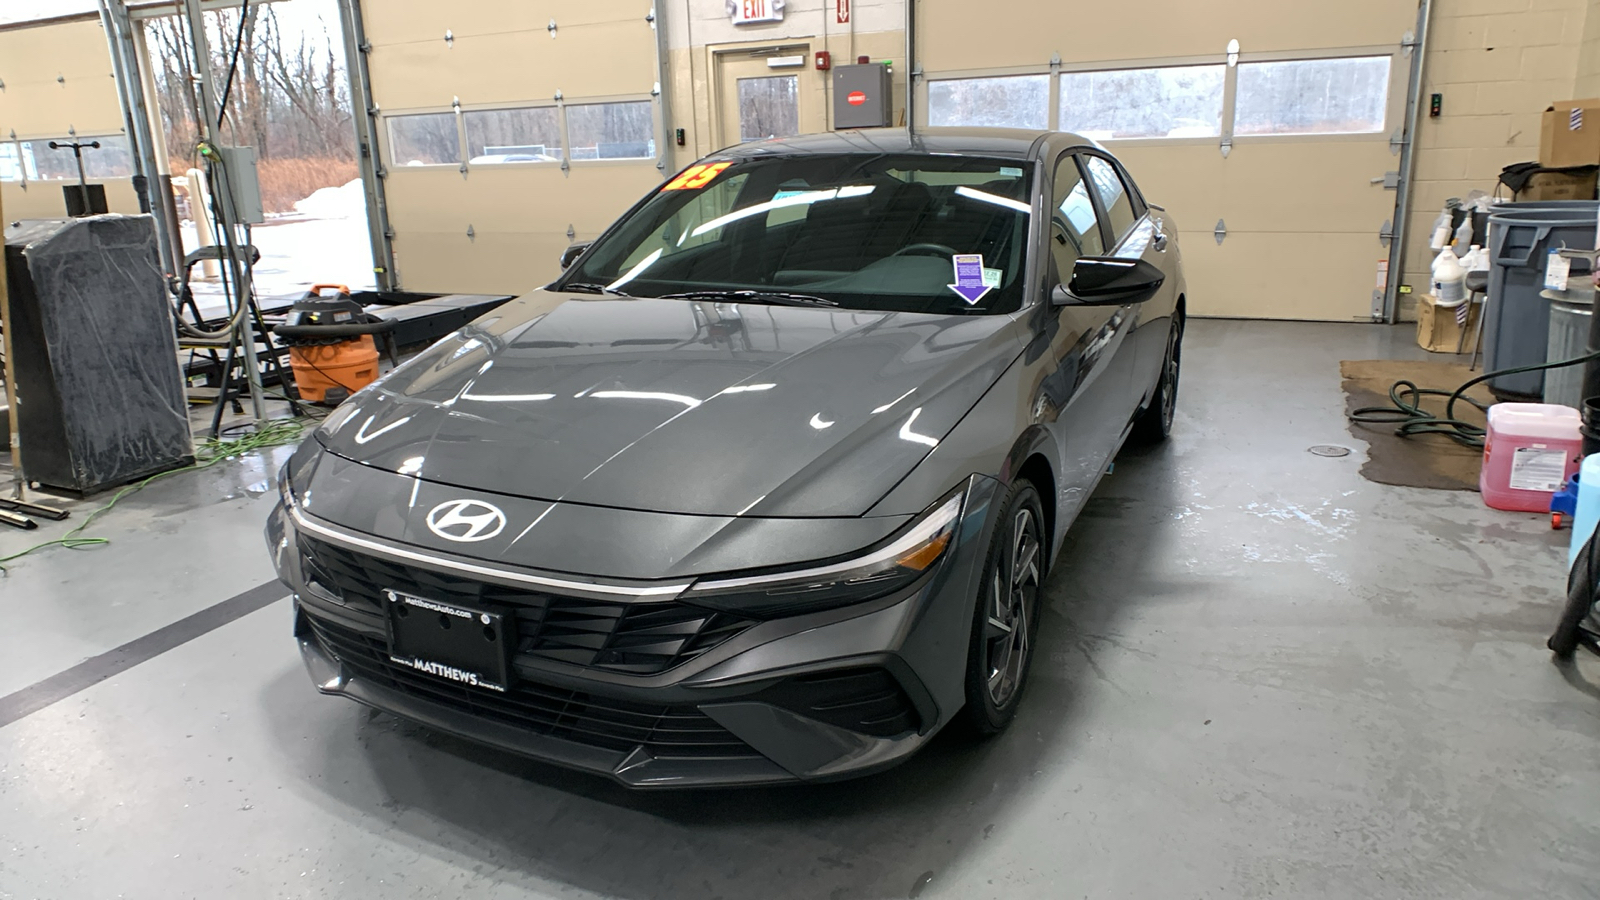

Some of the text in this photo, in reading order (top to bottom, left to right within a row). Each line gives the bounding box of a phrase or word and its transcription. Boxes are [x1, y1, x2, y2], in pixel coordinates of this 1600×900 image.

[743, 0, 765, 19] EXIT
[662, 162, 731, 190] 25
[404, 597, 472, 619] MatthewsAuto.com
[414, 658, 478, 686] MATTHEWS
